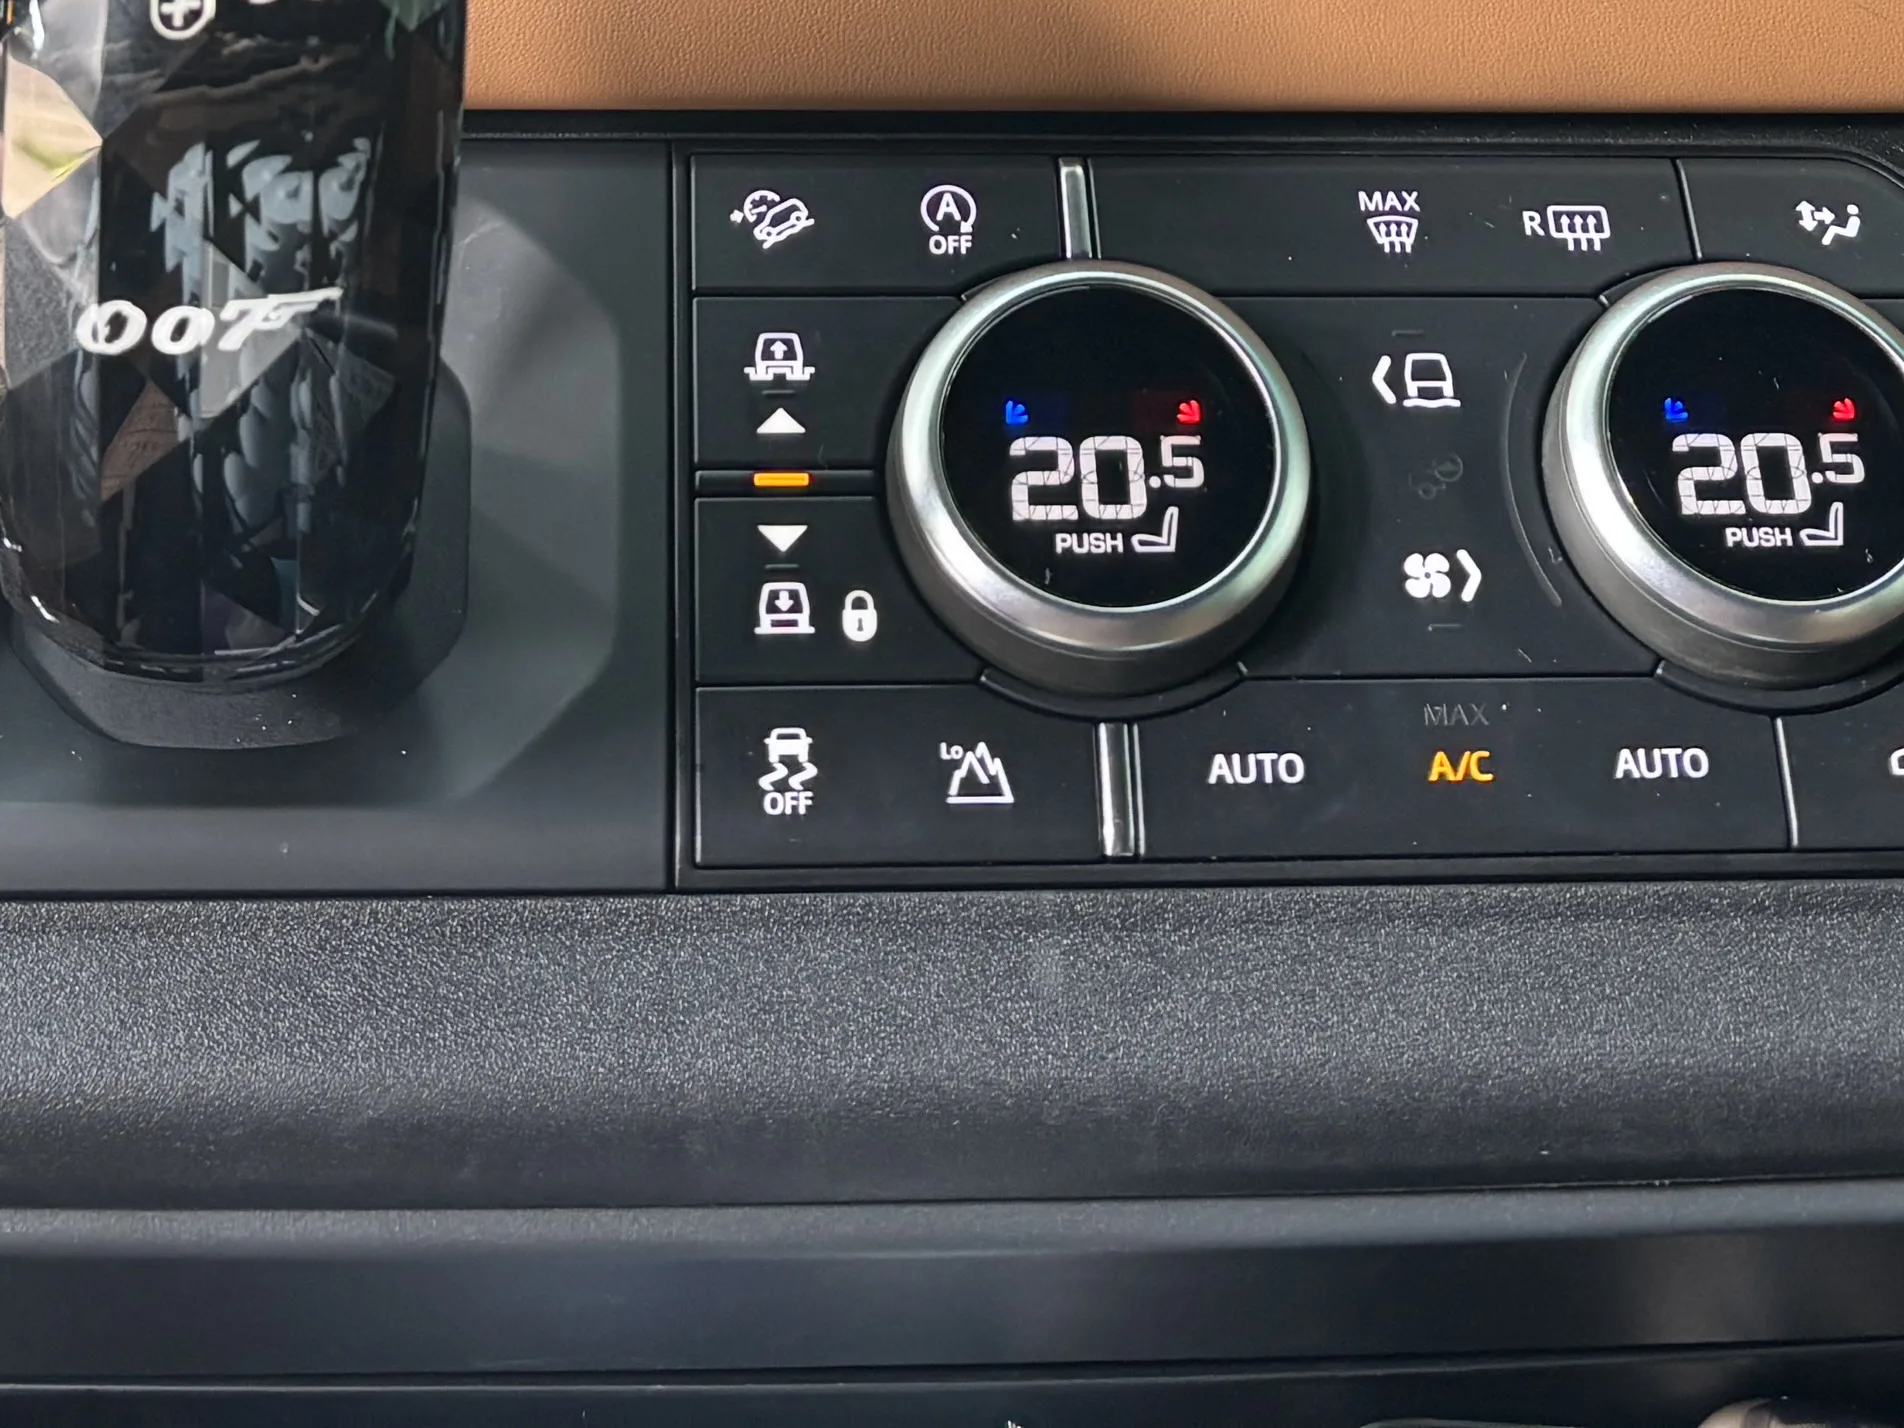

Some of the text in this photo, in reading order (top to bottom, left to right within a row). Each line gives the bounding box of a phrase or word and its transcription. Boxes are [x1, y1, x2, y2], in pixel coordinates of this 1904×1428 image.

[1358, 190, 1421, 212] MAX
[1523, 211, 1543, 236] R
[928, 234, 973, 255] OFF
[1009, 435, 1205, 521] 20.5
[1671, 432, 1866, 515] 20.5
[1055, 532, 1124, 554] PUSH
[1725, 526, 1793, 548] PUSH
[1423, 701, 1490, 728] MAX
[1207, 752, 1305, 785] AUTO
[1428, 750, 1494, 783] A/C
[1615, 747, 1709, 779] AUTO
[763, 791, 814, 815] OFF
